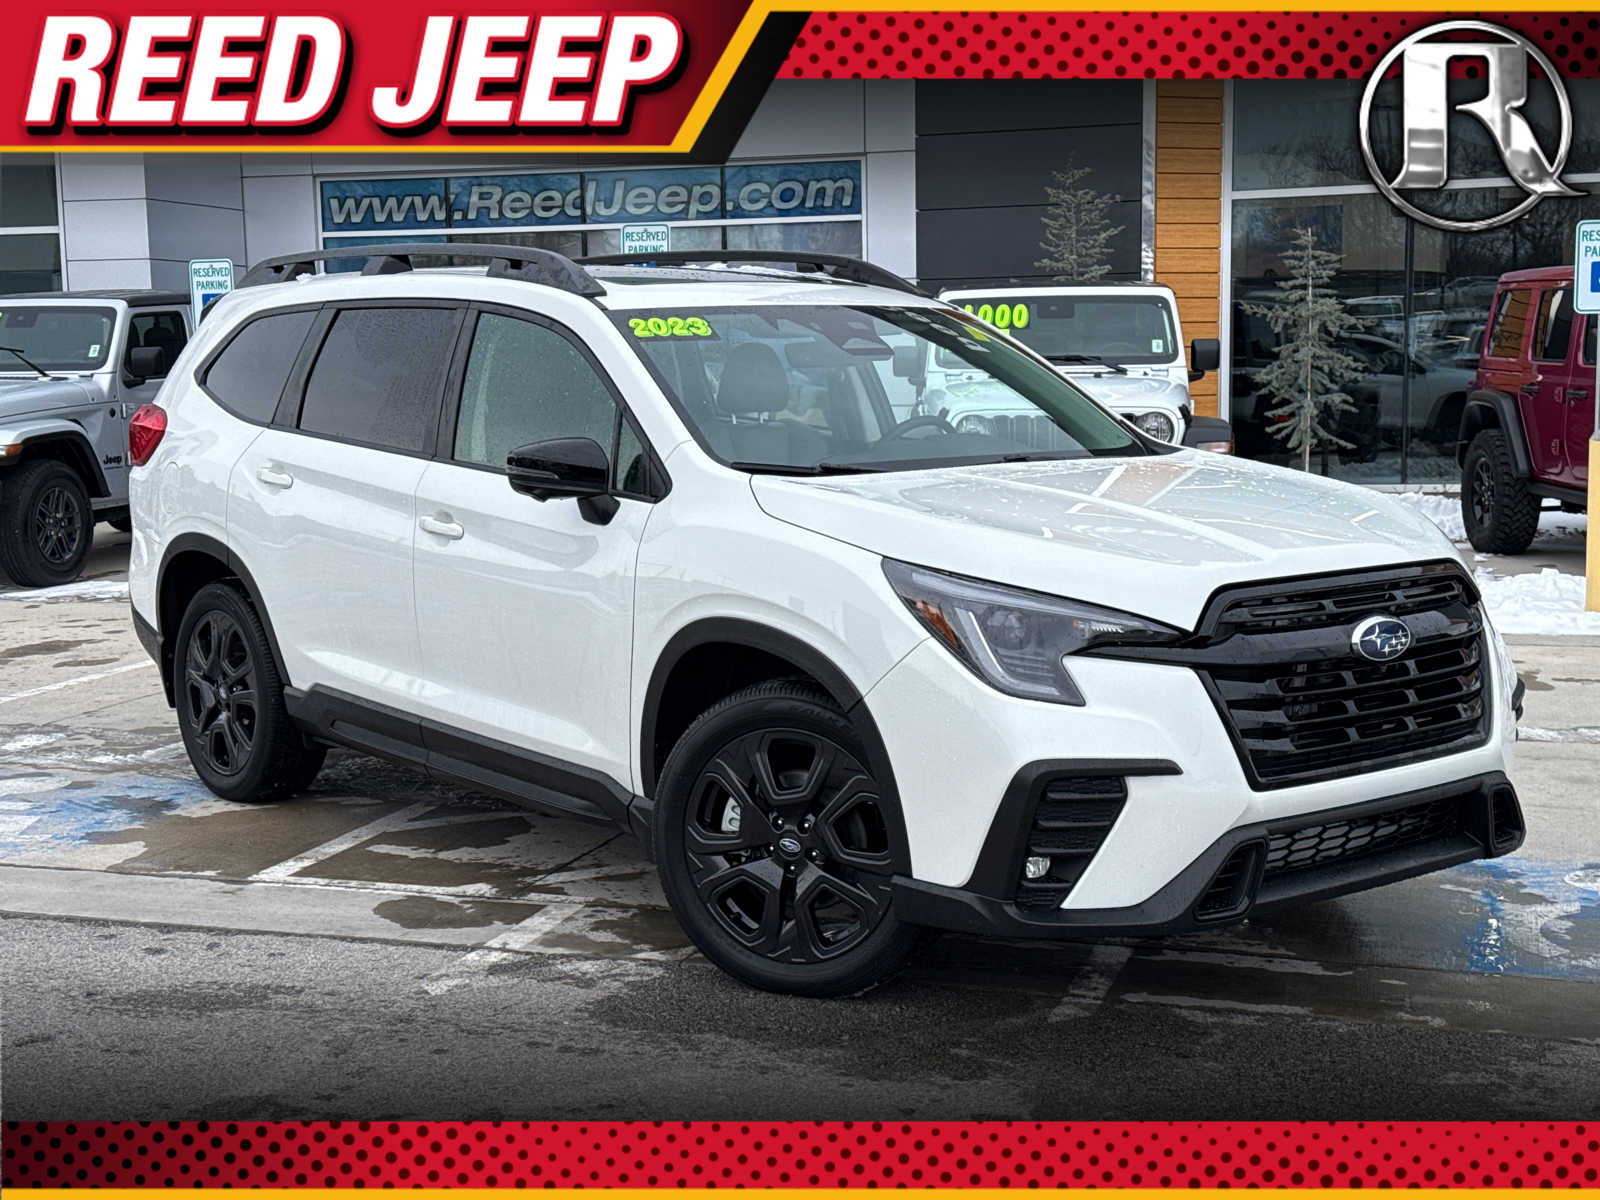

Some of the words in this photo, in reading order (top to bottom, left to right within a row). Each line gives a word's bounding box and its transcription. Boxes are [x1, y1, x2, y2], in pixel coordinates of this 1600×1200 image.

[328, 176, 855, 225] www.ReedJeep.com
[625, 230, 667, 241] RESERVED
[628, 244, 665, 254] PARKING
[193, 267, 230, 277] RESERVED
[196, 280, 228, 290] PARKING
[963, 303, 1029, 329] 000
[628, 316, 712, 337] 2023
